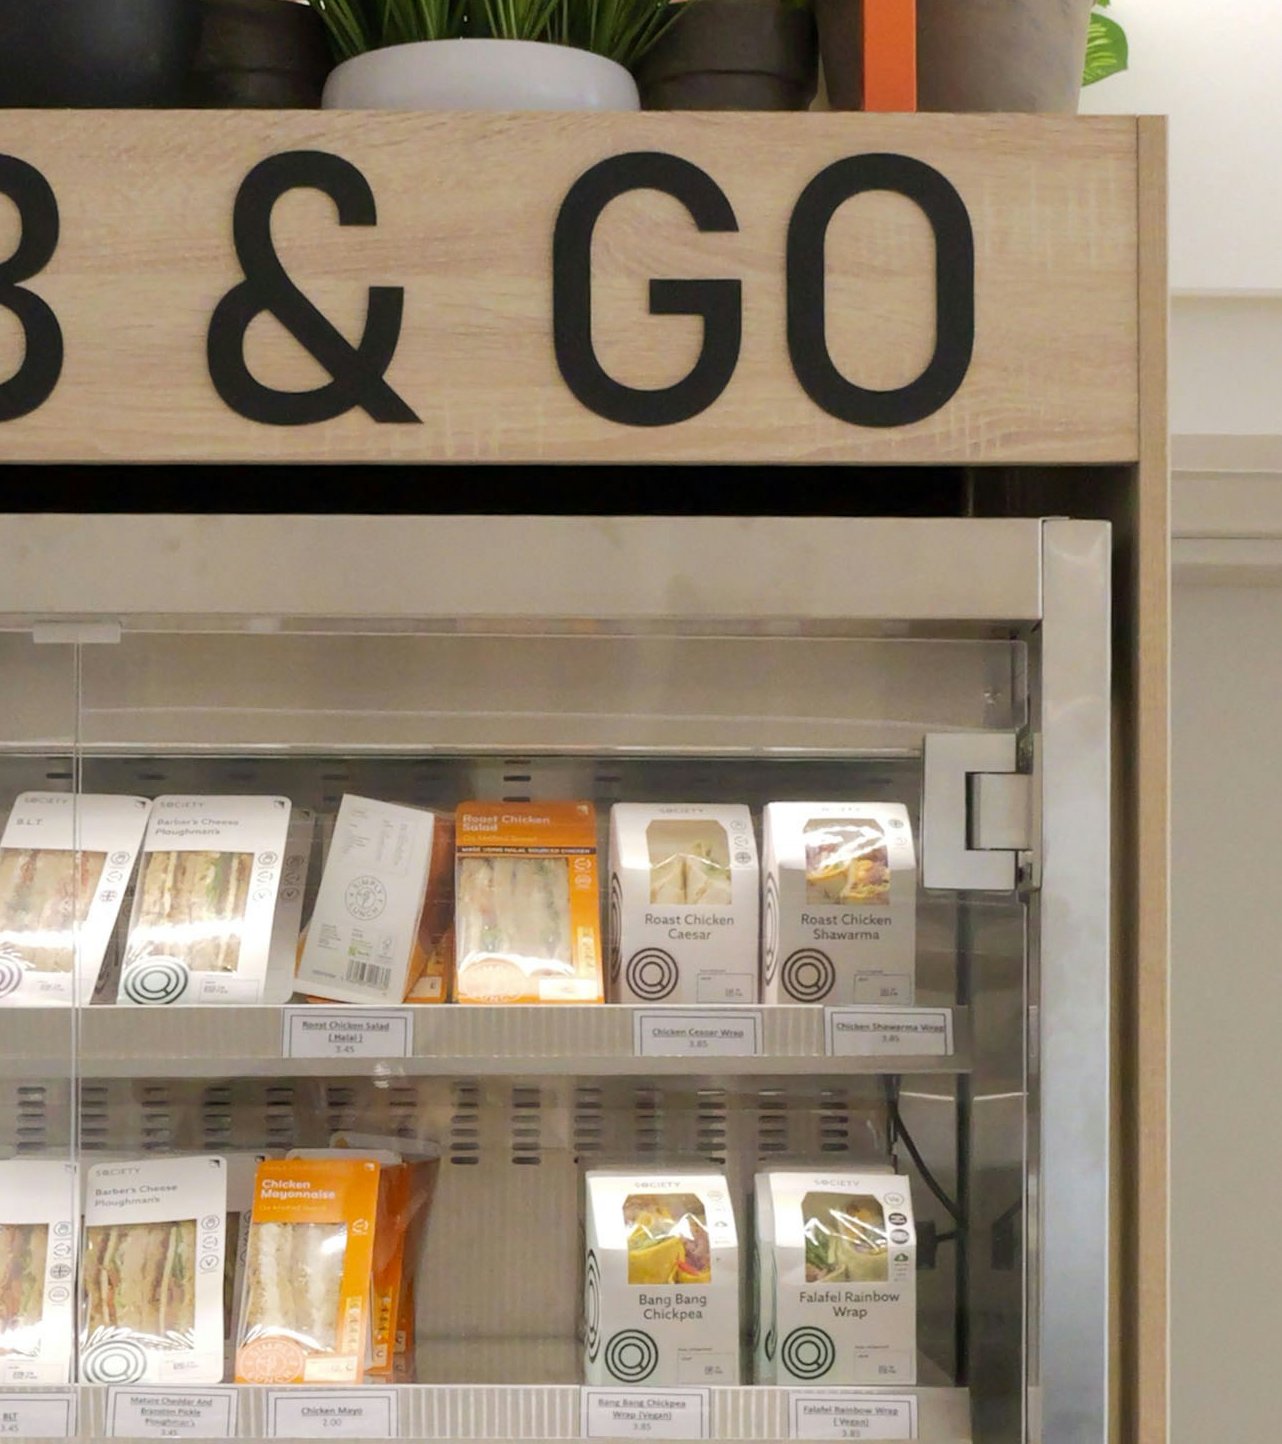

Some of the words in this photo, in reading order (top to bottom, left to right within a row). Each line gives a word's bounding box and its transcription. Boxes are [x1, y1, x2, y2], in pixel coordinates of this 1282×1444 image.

[205, 149, 424, 427] &
[551, 151, 975, 429] GO
[644, 913, 681, 926] Roast
[684, 914, 735, 926] Chicken
[801, 913, 838, 926] Roast
[841, 913, 892, 926] Chicken
[667, 928, 712, 941] Caesar
[813, 928, 880, 941] Shawarma
[261, 1179, 311, 1189] Chicken
[260, 1189, 336, 1200] Mayonnaise
[638, 1294, 672, 1309] Bang
[675, 1293, 707, 1308] Bang
[799, 1291, 842, 1303] Falafel
[844, 1290, 900, 1303] Rainbow
[643, 1304, 703, 1323] Chickpea
[832, 1306, 868, 1320] Wrap
[301, 1407, 336, 1416] Chicken
[339, 1407, 363, 1416] Mayo
